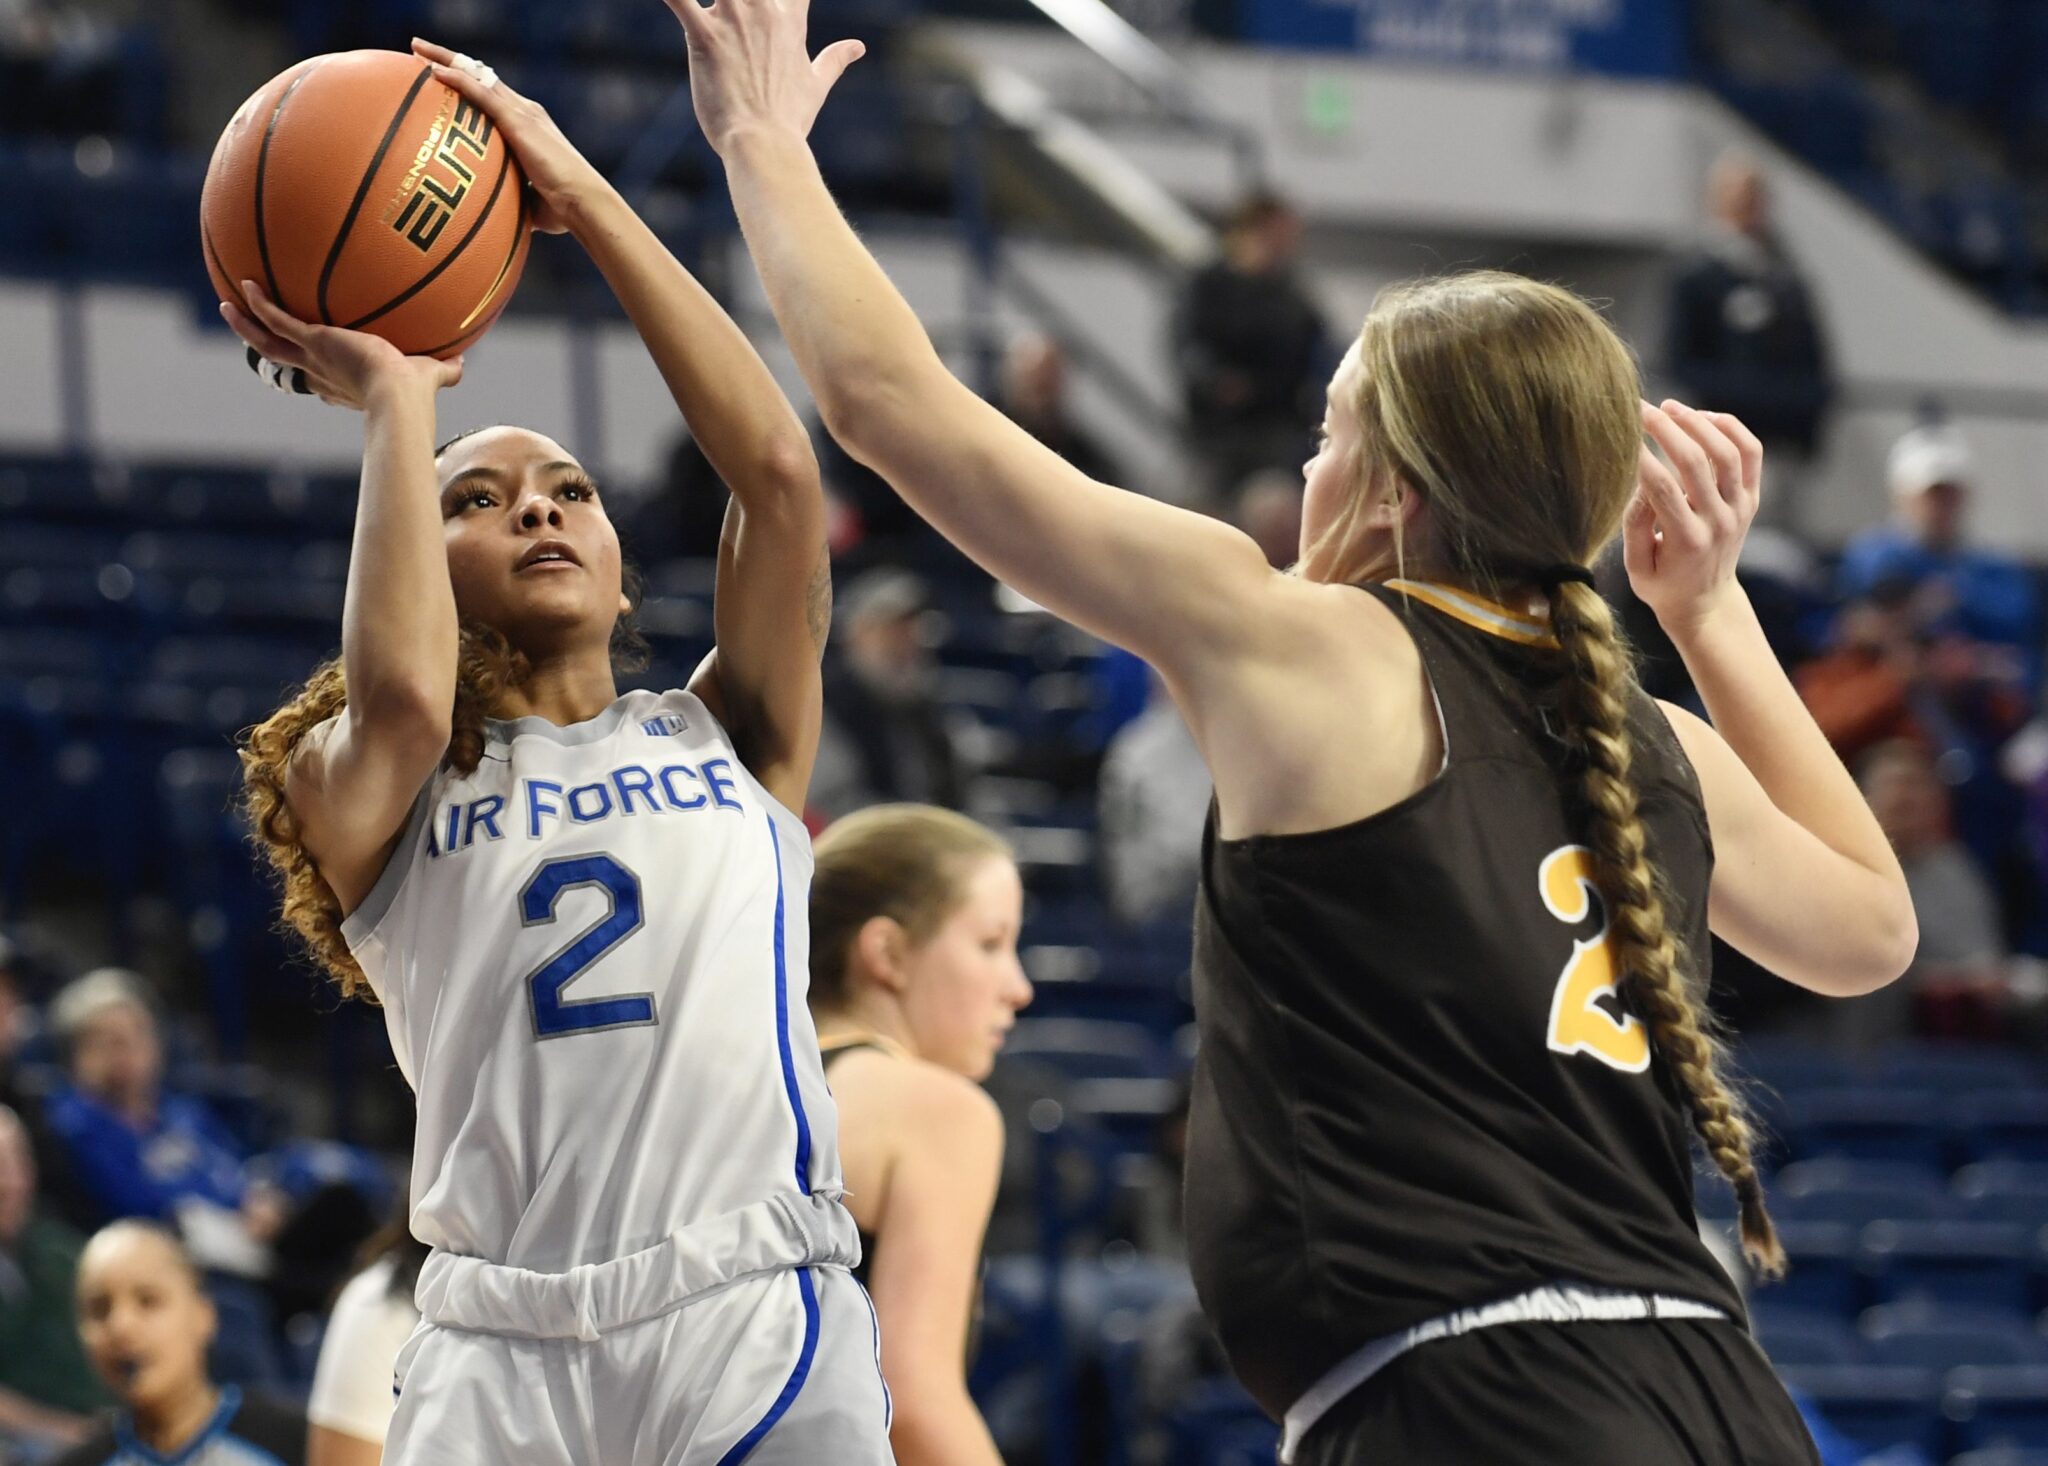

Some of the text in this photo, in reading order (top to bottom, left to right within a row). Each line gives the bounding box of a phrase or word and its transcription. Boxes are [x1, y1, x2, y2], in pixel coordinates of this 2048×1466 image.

[392, 97, 496, 254] ELITE
[522, 756, 745, 840] FORCE
[517, 850, 659, 1041] 2
[1538, 844, 1651, 1074] 2
